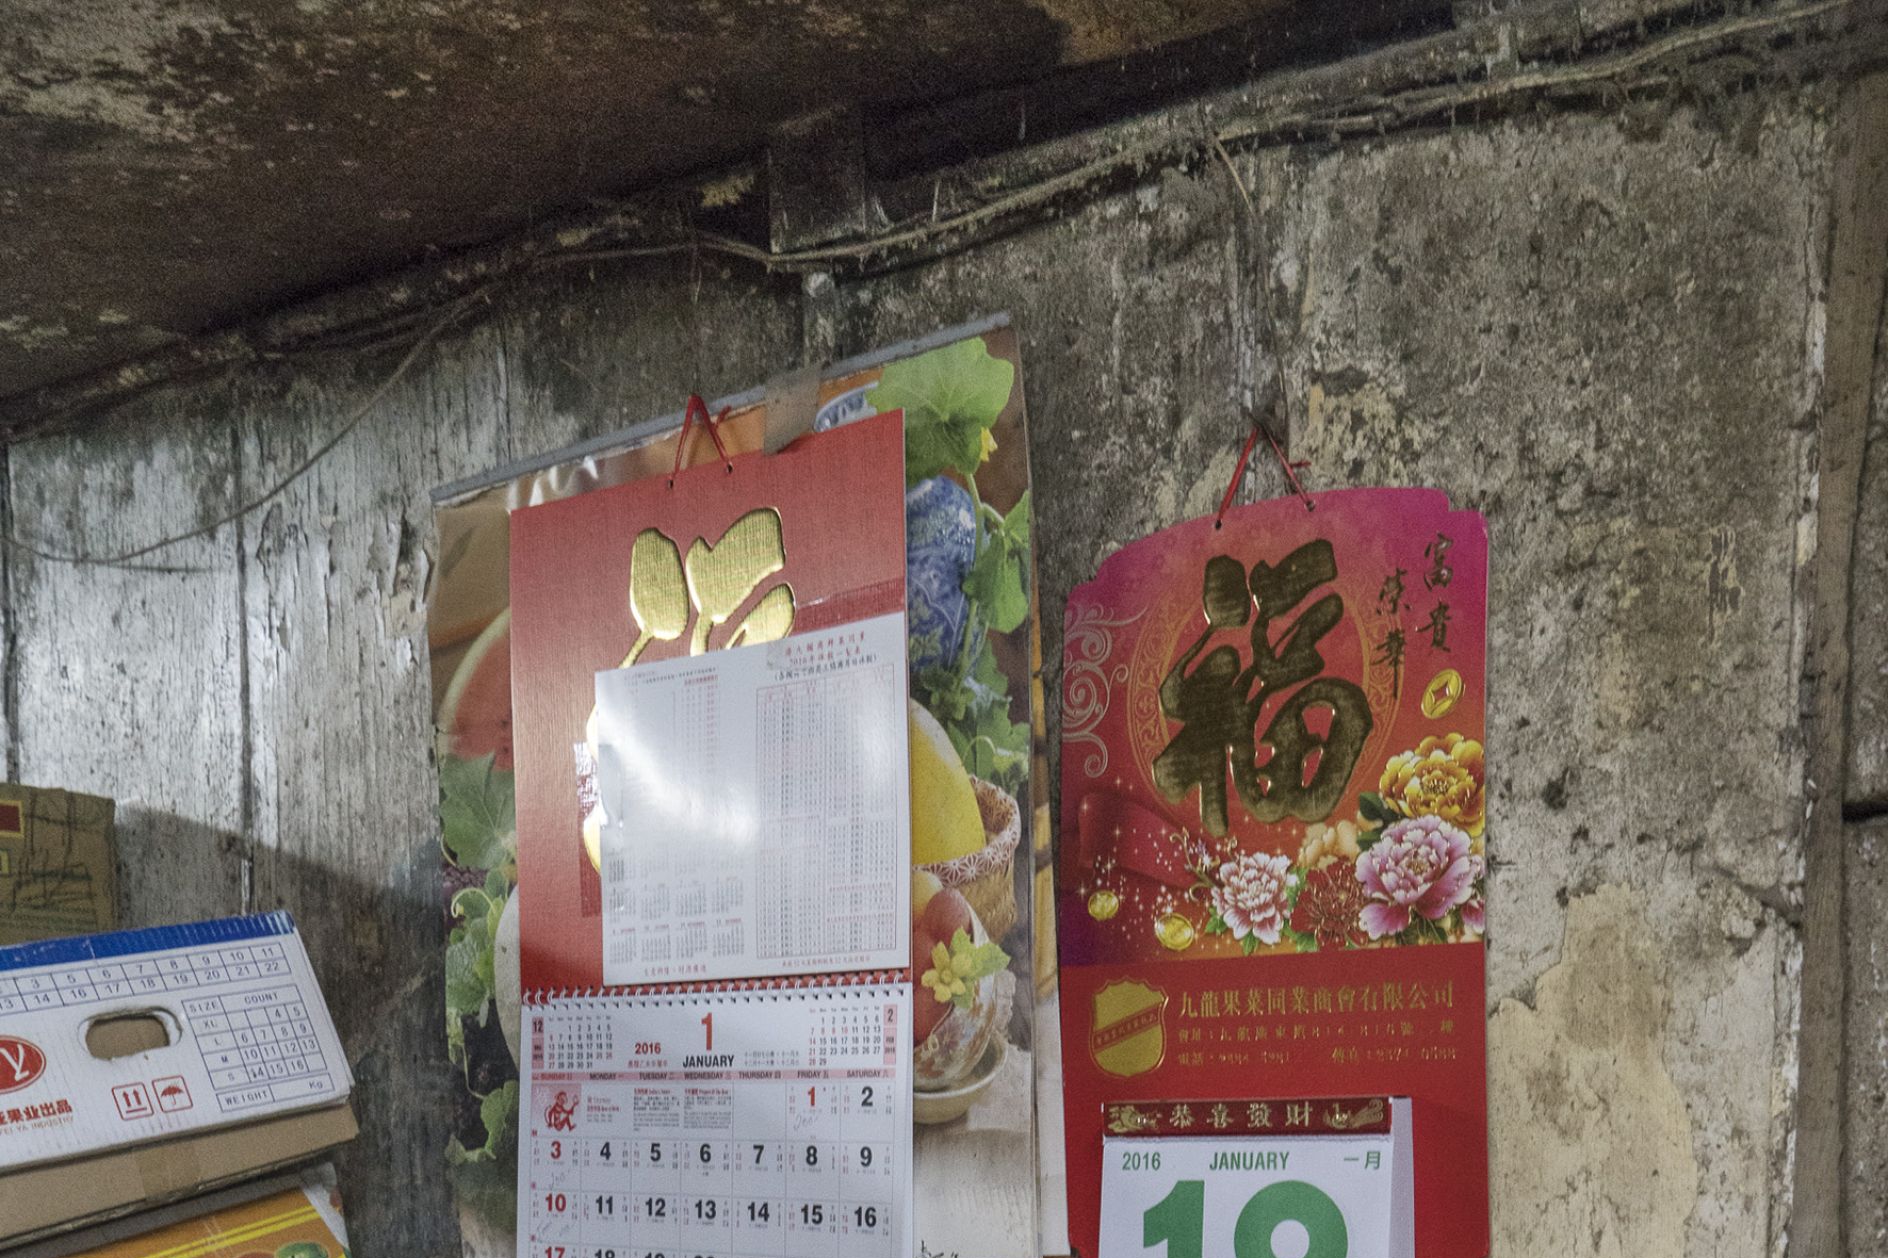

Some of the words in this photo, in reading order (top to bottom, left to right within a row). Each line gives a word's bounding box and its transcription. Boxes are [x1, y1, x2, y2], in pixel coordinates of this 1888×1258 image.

[1152, 539, 1374, 837] 福
[31, 979, 40, 989] 3
[67, 974, 76, 983] 5
[102, 969, 111, 978] 6
[136, 964, 143, 974] 7
[170, 961, 178, 969] 8
[202, 955, 210, 965] 9
[230, 952, 244, 961] 10
[262, 947, 274, 957] 11
[33, 993, 50, 1004] 14
[71, 988, 87, 999] 16
[105, 983, 120, 994] 17
[140, 978, 156, 989] 18
[173, 974, 188, 984] 19
[205, 970, 220, 980] 20
[236, 966, 250, 976] 21
[265, 962, 279, 972] 22
[189, 1000, 218, 1013] SIZE
[244, 992, 279, 1005] COUNT
[204, 1018, 217, 1028] XL
[275, 1008, 282, 1018] 4
[293, 1007, 301, 1016] 5
[887, 1008, 894, 1023] 2
[241, 1033, 248, 1043] 6
[260, 1029, 267, 1040] 7
[281, 1027, 288, 1037] 8
[299, 1023, 307, 1033] 9
[533, 1020, 543, 1033] 12
[701, 1012, 713, 1051] 1
[221, 1055, 228, 1063] M
[244, 1050, 258, 1061] 10
[264, 1046, 276, 1057] 11
[284, 1042, 296, 1053] 12
[302, 1038, 316, 1050] 13
[635, 1042, 661, 1054] 2016
[251, 1067, 264, 1078] 14
[270, 1063, 284, 1075] 15
[290, 1059, 304, 1071] 16
[683, 1055, 734, 1068] JANUARY
[590, 1072, 616, 1080] MONDAY
[639, 1072, 667, 1080] TUESDAY
[684, 1071, 723, 1080] WEDNESDAY
[739, 1071, 772, 1079] THURSDAY
[797, 1070, 820, 1078] FRIDAY
[847, 1070, 880, 1079] SATURDAY
[224, 1091, 268, 1106] WEIGHT
[309, 1081, 323, 1090] Kg
[808, 1086, 816, 1107] 1
[861, 1086, 874, 1107] 2
[1170, 1102, 1312, 1128] 恭喜發財
[551, 1140, 562, 1159] 3
[600, 1142, 611, 1160] 4
[650, 1143, 661, 1162] 5
[700, 1143, 711, 1163] 6
[752, 1145, 765, 1164] 7
[806, 1145, 818, 1166] 8
[860, 1146, 873, 1167] 9
[1122, 1152, 1161, 1171] 2016
[1209, 1151, 1290, 1171] JANUARY
[1343, 1151, 1381, 1170] 一月
[545, 1193, 567, 1212] 10
[596, 1195, 614, 1215] 11
[645, 1198, 666, 1217] 12
[695, 1199, 716, 1220] 13
[747, 1201, 770, 1222] 14
[801, 1204, 823, 1225] 15
[854, 1206, 877, 1228] 16
